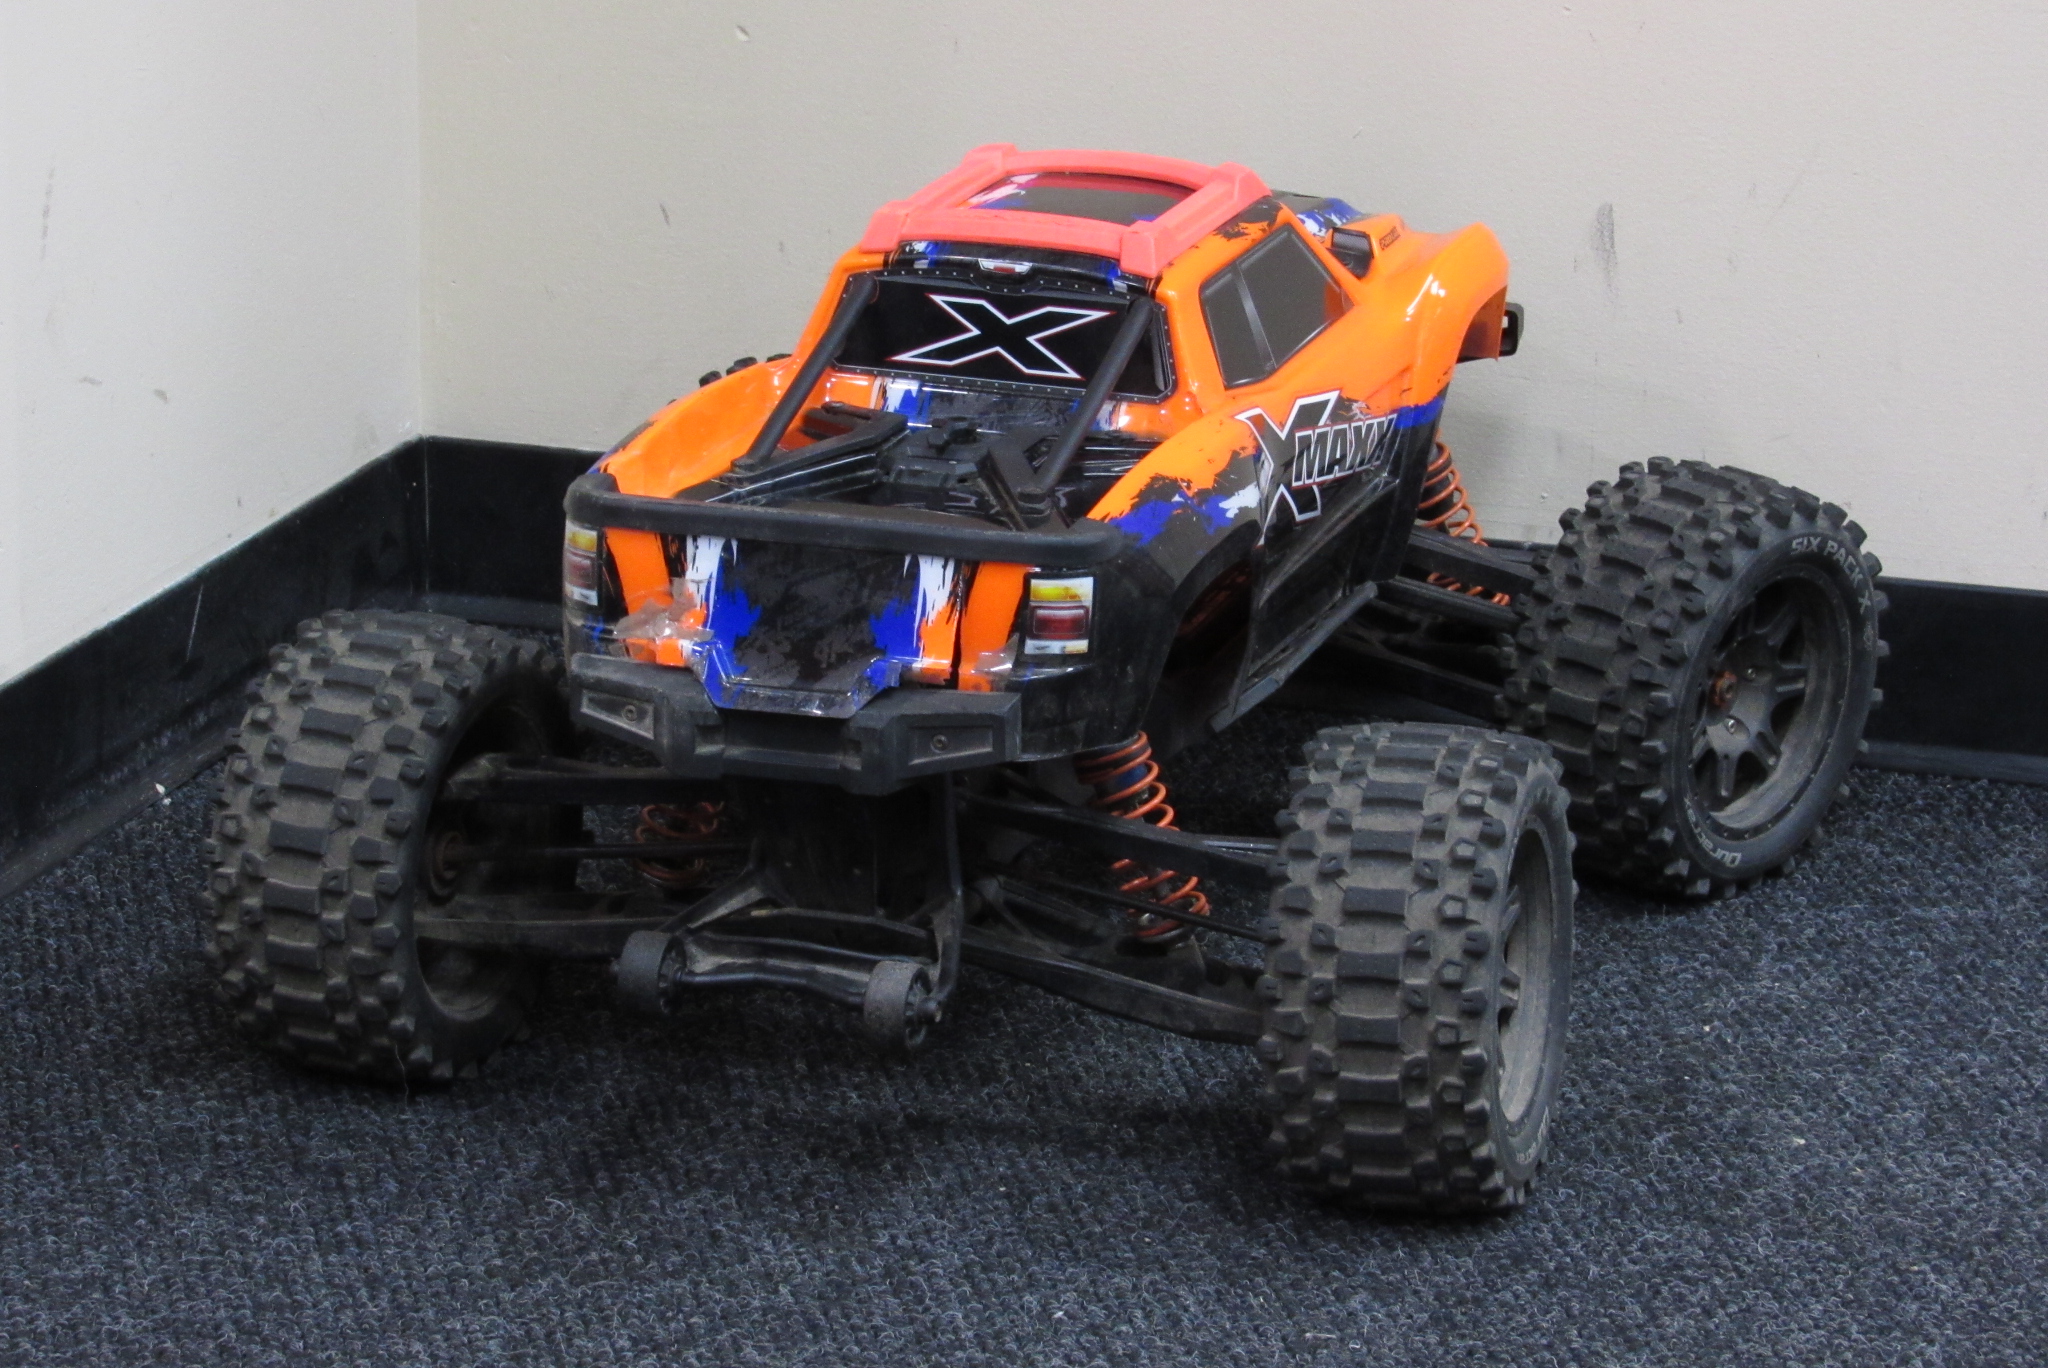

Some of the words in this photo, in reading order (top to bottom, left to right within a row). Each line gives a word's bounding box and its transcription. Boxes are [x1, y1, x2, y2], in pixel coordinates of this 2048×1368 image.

[887, 294, 1114, 380] X
[1790, 536, 1821, 555] SIX
[1823, 540, 1864, 588] PACK
